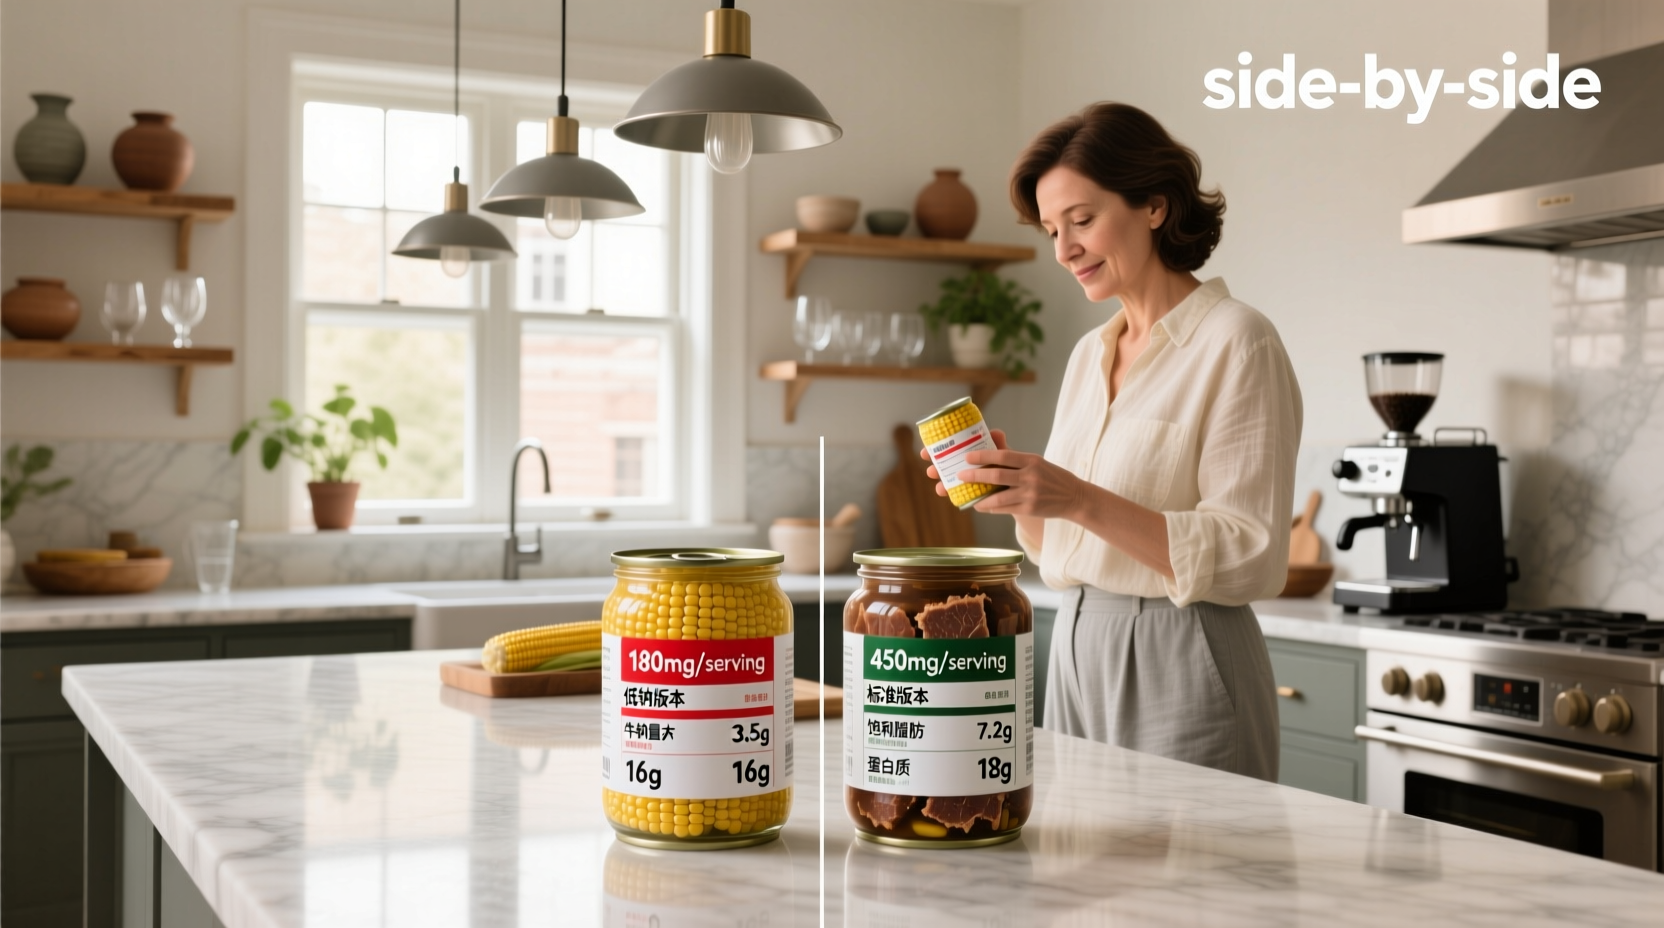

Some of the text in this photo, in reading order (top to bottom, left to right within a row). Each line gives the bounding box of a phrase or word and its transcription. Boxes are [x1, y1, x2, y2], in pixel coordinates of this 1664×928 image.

[628, 649, 765, 679] 180mg/serving
[870, 648, 1007, 677] 450mg/serving
[731, 722, 770, 747] 3.5g
[976, 720, 1013, 744] 7.2g
[626, 759, 662, 791] 16g
[732, 758, 770, 788] 16g
[977, 756, 1013, 785] 18g
